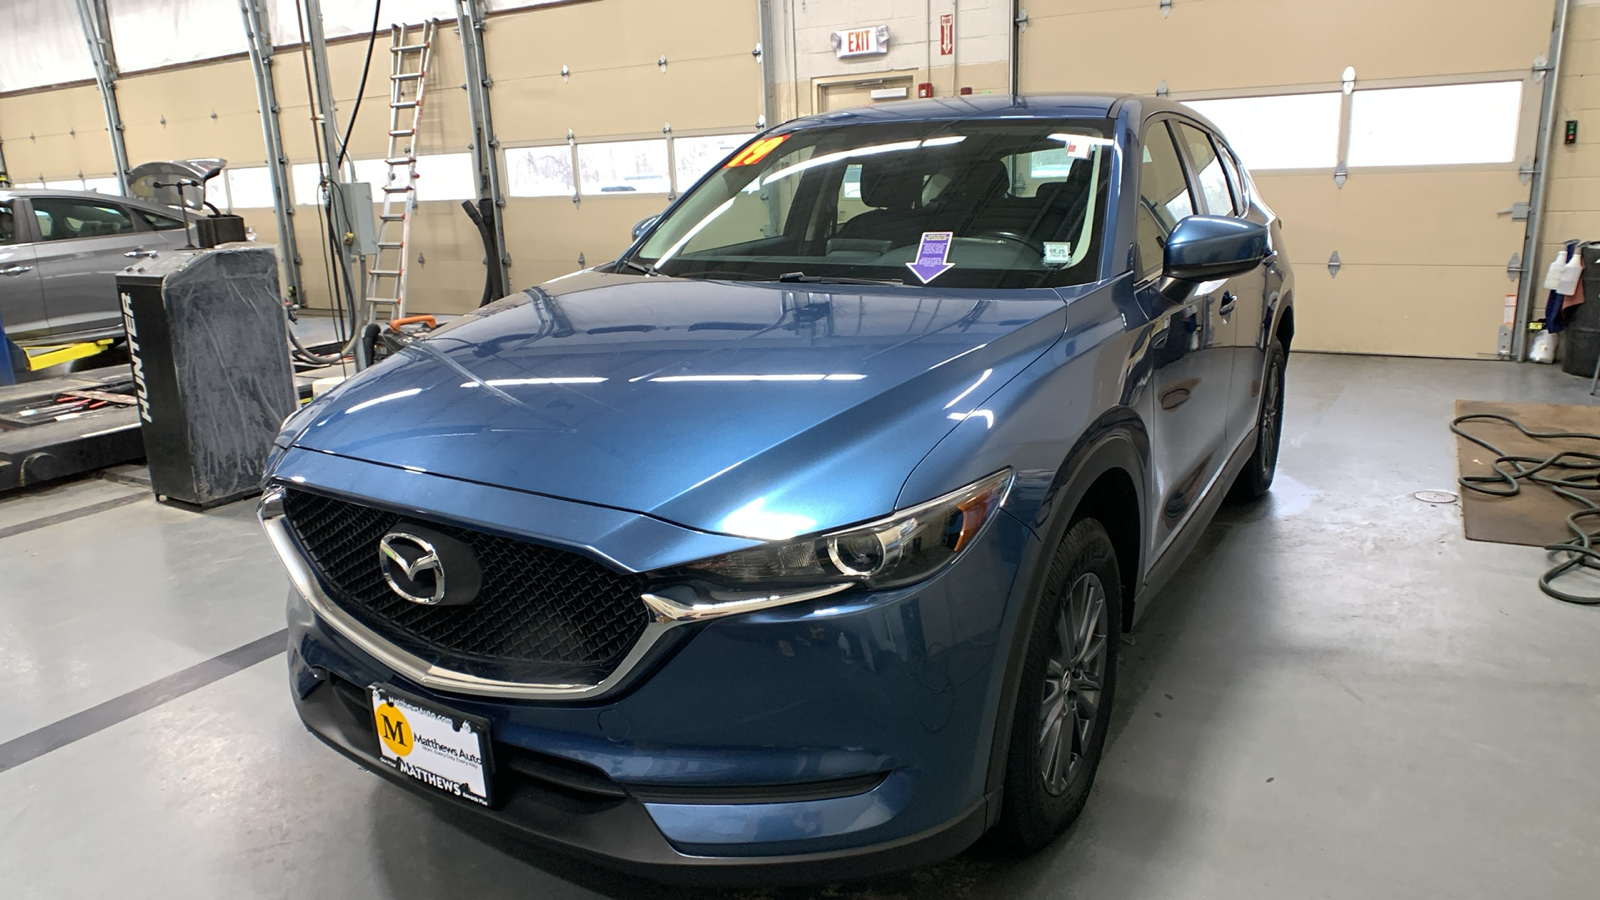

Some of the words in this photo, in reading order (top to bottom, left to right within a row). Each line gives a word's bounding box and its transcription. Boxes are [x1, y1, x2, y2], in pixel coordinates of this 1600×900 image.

[848, 30, 870, 52] EXIT
[727, 136, 784, 167] 19
[121, 292, 152, 423] HUNTER
[380, 713, 408, 747] M
[413, 732, 458, 757] Matthews
[459, 749, 482, 765] Auto
[400, 762, 461, 796] MATTHEWS
